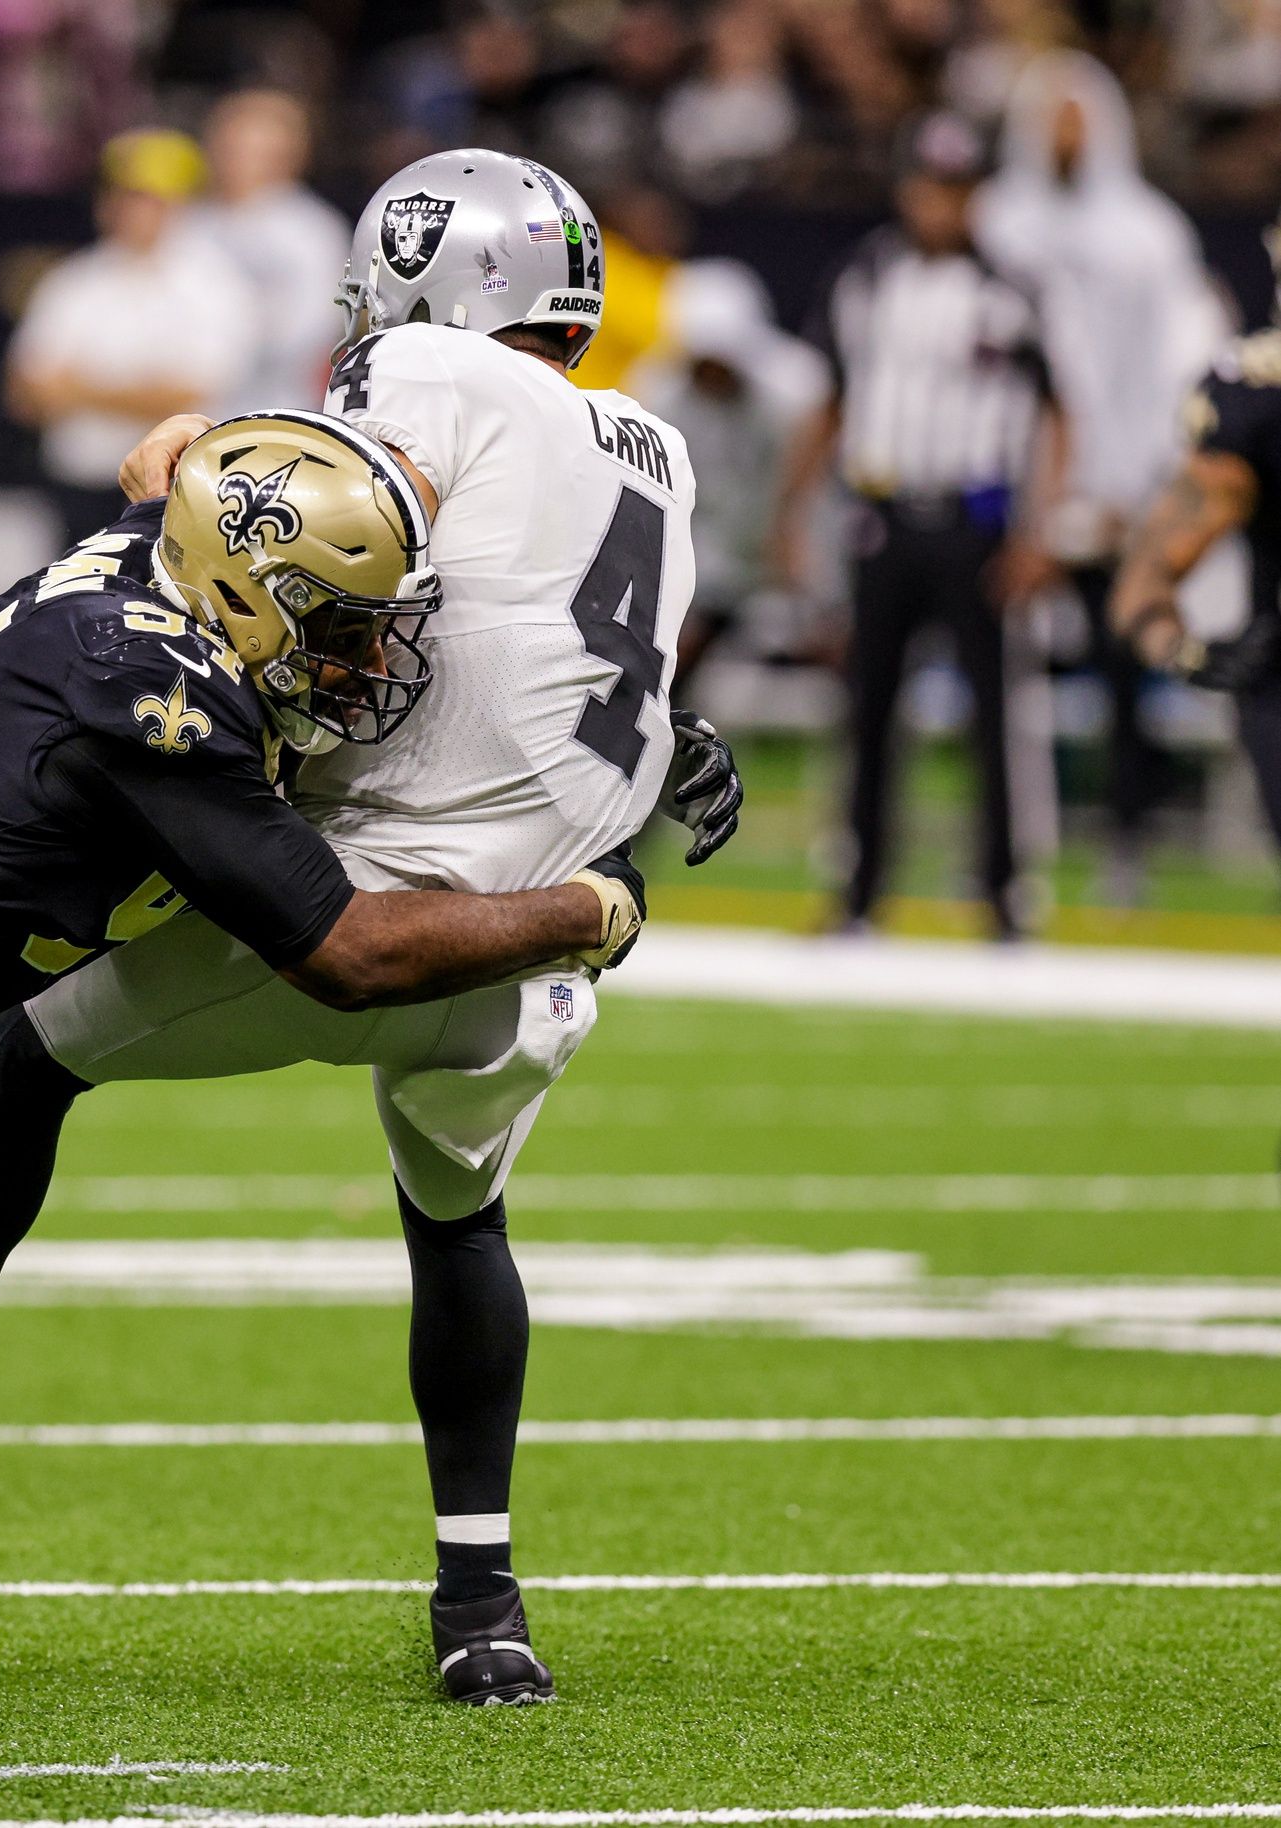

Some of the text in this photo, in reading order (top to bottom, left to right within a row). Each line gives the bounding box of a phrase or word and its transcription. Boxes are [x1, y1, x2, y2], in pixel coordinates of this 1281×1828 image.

[390, 201, 447, 211] RAIDERS
[482, 280, 508, 290] CATCH
[586, 255, 600, 291] 4
[549, 297, 601, 315] RAIDERS
[328, 332, 389, 415] 4
[584, 396, 673, 492] CARR
[568, 481, 668, 788] 4
[552, 999, 571, 1018] NFL
